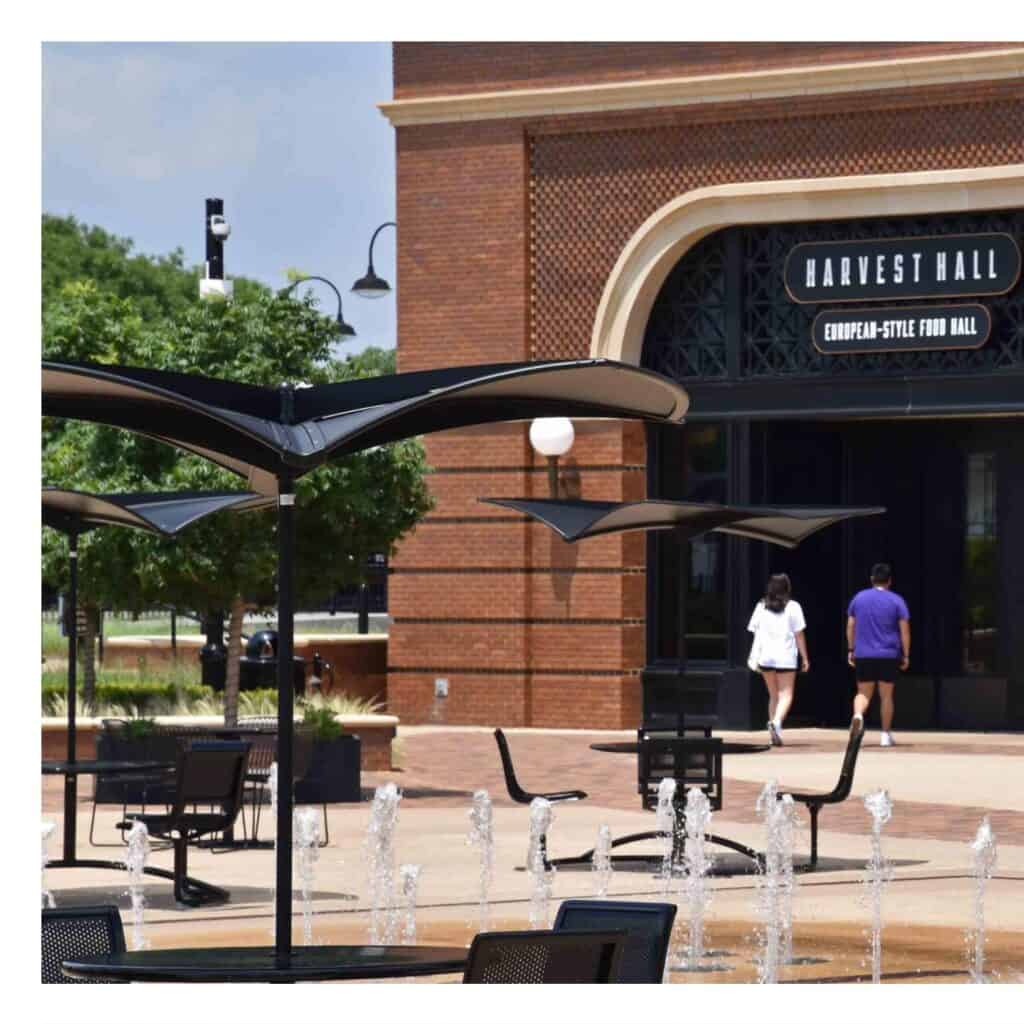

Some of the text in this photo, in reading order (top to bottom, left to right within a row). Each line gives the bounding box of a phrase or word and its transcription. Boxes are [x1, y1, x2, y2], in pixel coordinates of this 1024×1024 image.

[806, 248, 998, 288] HARVEST HALL
[824, 315, 978, 342] EUROPEAN-STYLE FOOD HALL
